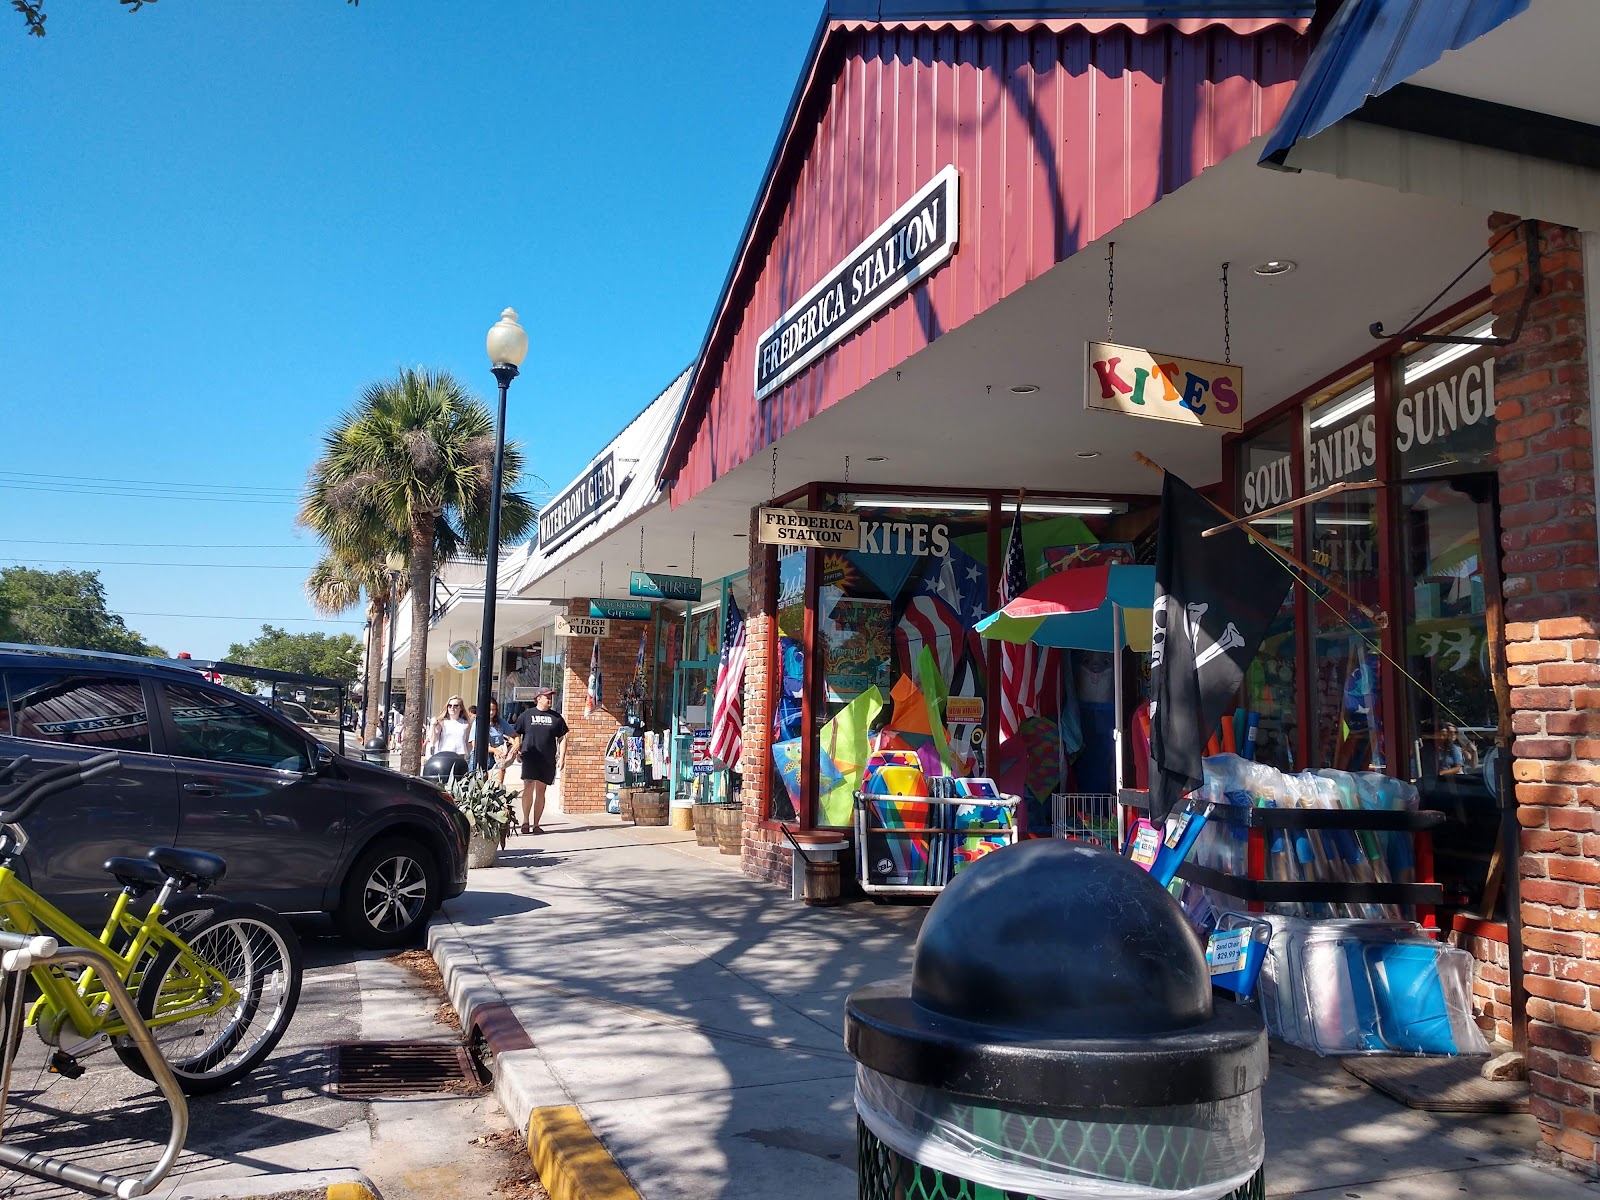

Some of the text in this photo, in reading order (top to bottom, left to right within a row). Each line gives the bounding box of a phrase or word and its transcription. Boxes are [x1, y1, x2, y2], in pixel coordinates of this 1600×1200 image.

[761, 197, 939, 380] FREDERICA STATION
[1092, 356, 1239, 416] KITES
[540, 459, 613, 544] WATERFRONT GIFTS
[765, 513, 855, 531] FREDERICA
[778, 527, 843, 543] STATION
[858, 520, 950, 557] KITES
[635, 577, 697, 595] T-SHIRTS
[592, 600, 649, 609] WATERFRONT
[569, 625, 606, 635] FUDGE
[581, 618, 605, 626] FRESH
[1228, 941, 1240, 949] Chair
[1217, 950, 1236, 960] $29.99
